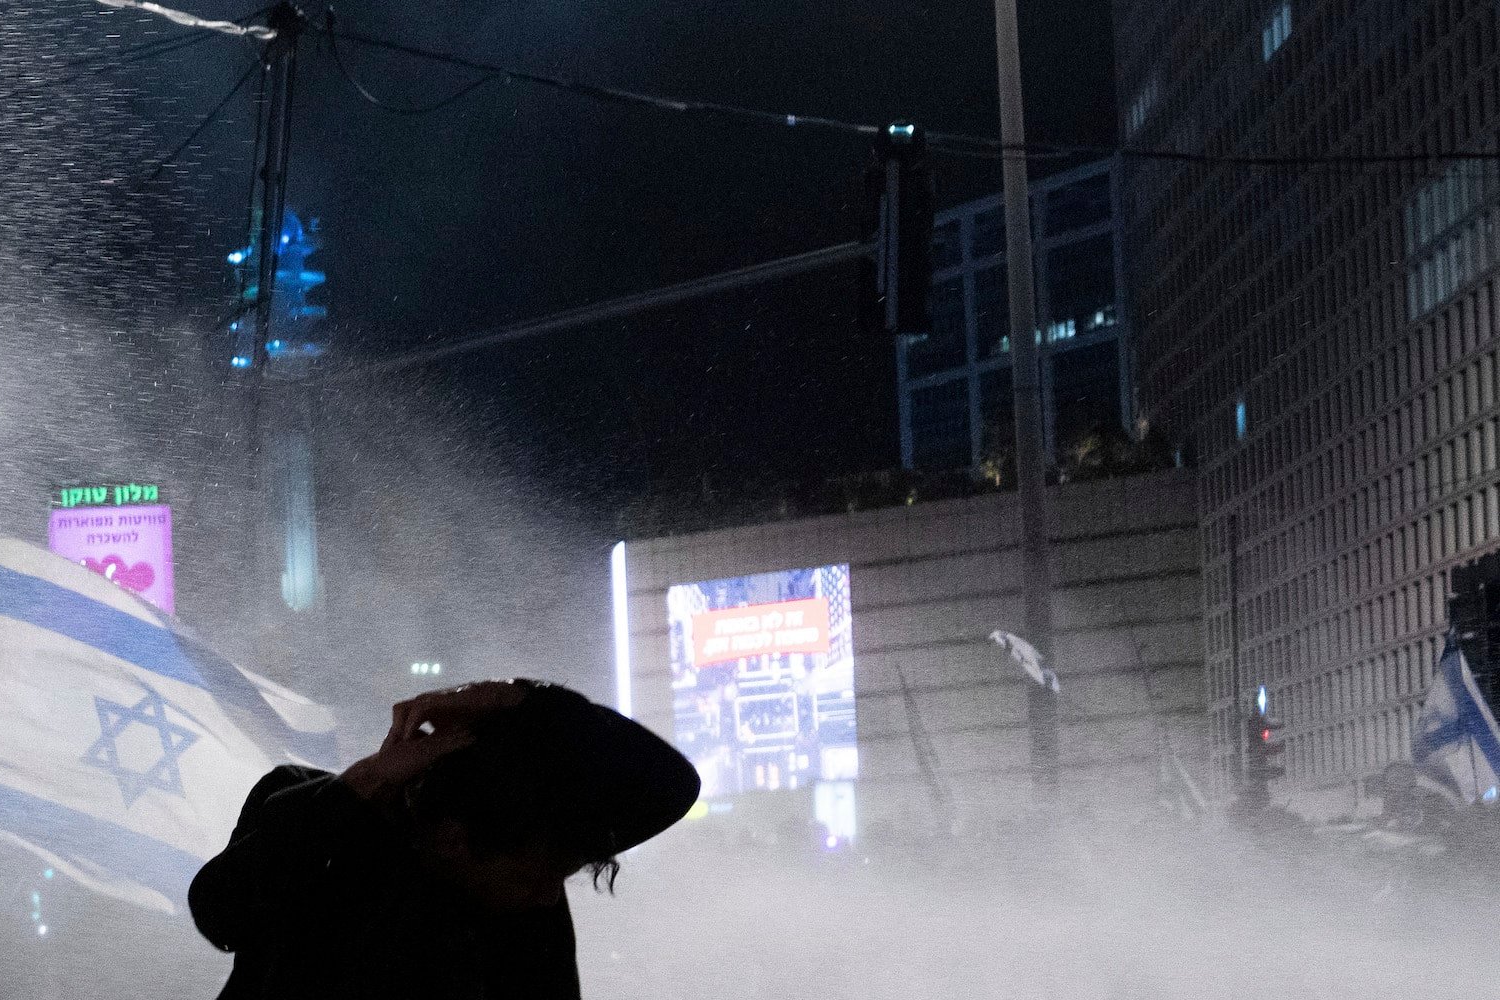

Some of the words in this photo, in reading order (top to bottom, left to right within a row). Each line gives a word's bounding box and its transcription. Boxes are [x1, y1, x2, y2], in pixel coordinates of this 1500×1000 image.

[114, 483, 158, 506] מלון
[58, 515, 113, 528] מפוארות
[118, 514, 167, 526] סוויטות
[86, 530, 139, 544] להשכרה
